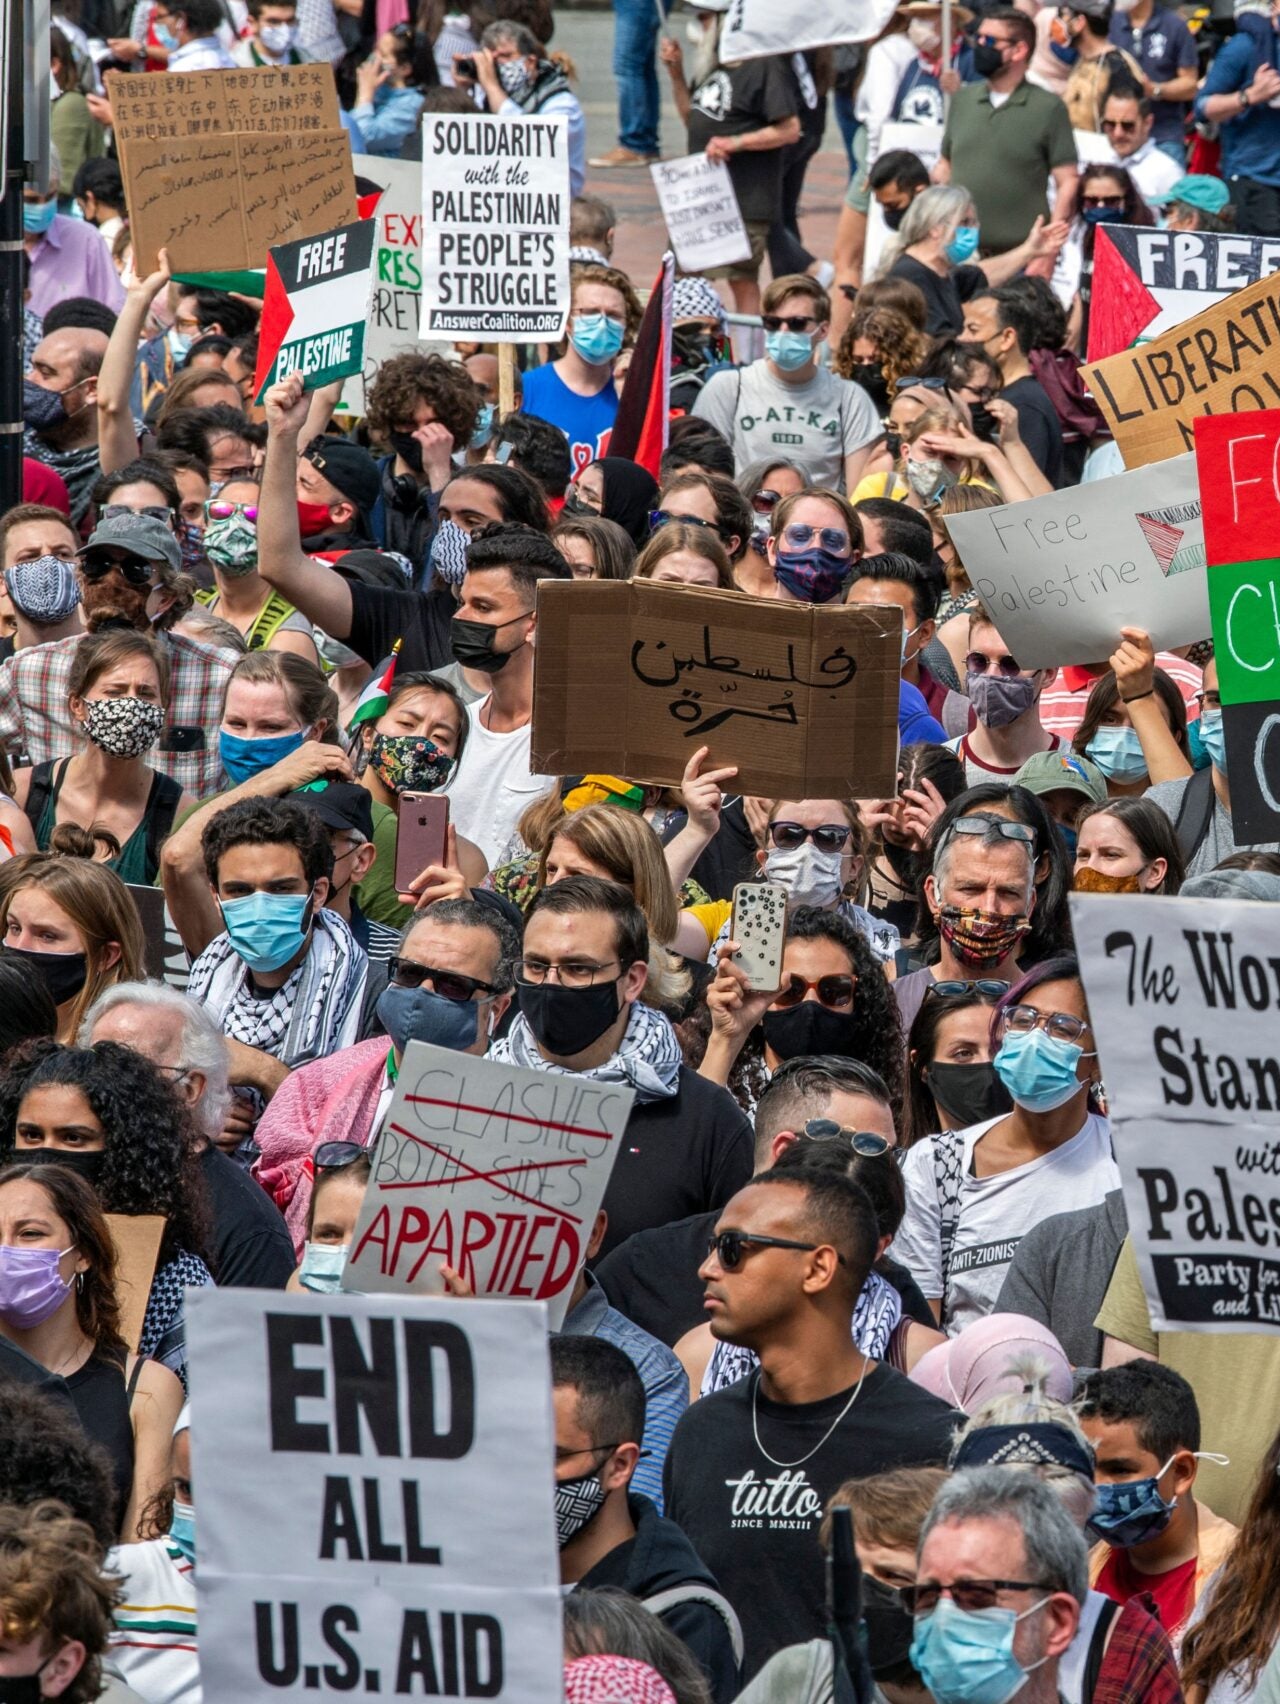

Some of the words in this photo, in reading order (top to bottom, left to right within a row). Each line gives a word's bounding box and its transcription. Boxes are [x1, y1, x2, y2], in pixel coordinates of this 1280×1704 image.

[433, 120, 559, 157] SOLIDARITY
[465, 160, 501, 185] with
[506, 160, 530, 185] the
[432, 190, 560, 225] PALESTINIAN
[297, 233, 348, 283] FREE
[439, 233, 555, 267] PEOPLE'S
[438, 271, 557, 305] STRUGGLE
[433, 312, 560, 331] AnswerCoalition.ORG
[275, 328, 353, 384] PALESTINE
[740, 406, 838, 437] O-AT-KA
[988, 508, 1088, 553] Free
[976, 560, 1140, 618] Palestine
[631, 625, 858, 689] فلسطين
[1104, 929, 1180, 1007] The
[413, 1069, 621, 1158] CLASHES
[374, 1131, 466, 1194] BOTH
[490, 1155, 588, 1207] SIDES
[350, 1204, 581, 1301] APARTIED
[1174, 1256, 1251, 1293] Party
[1257, 1261, 1280, 1292] for
[1212, 1293, 1250, 1315] and
[264, 1311, 476, 1461] END
[725, 1469, 823, 1519] tutto.
[318, 1475, 443, 1566] ALL
[731, 1519, 763, 1529] SINCE
[769, 1520, 812, 1530] MMXIII
[253, 1600, 382, 1693] U.S.
[395, 1608, 505, 1700] AID
